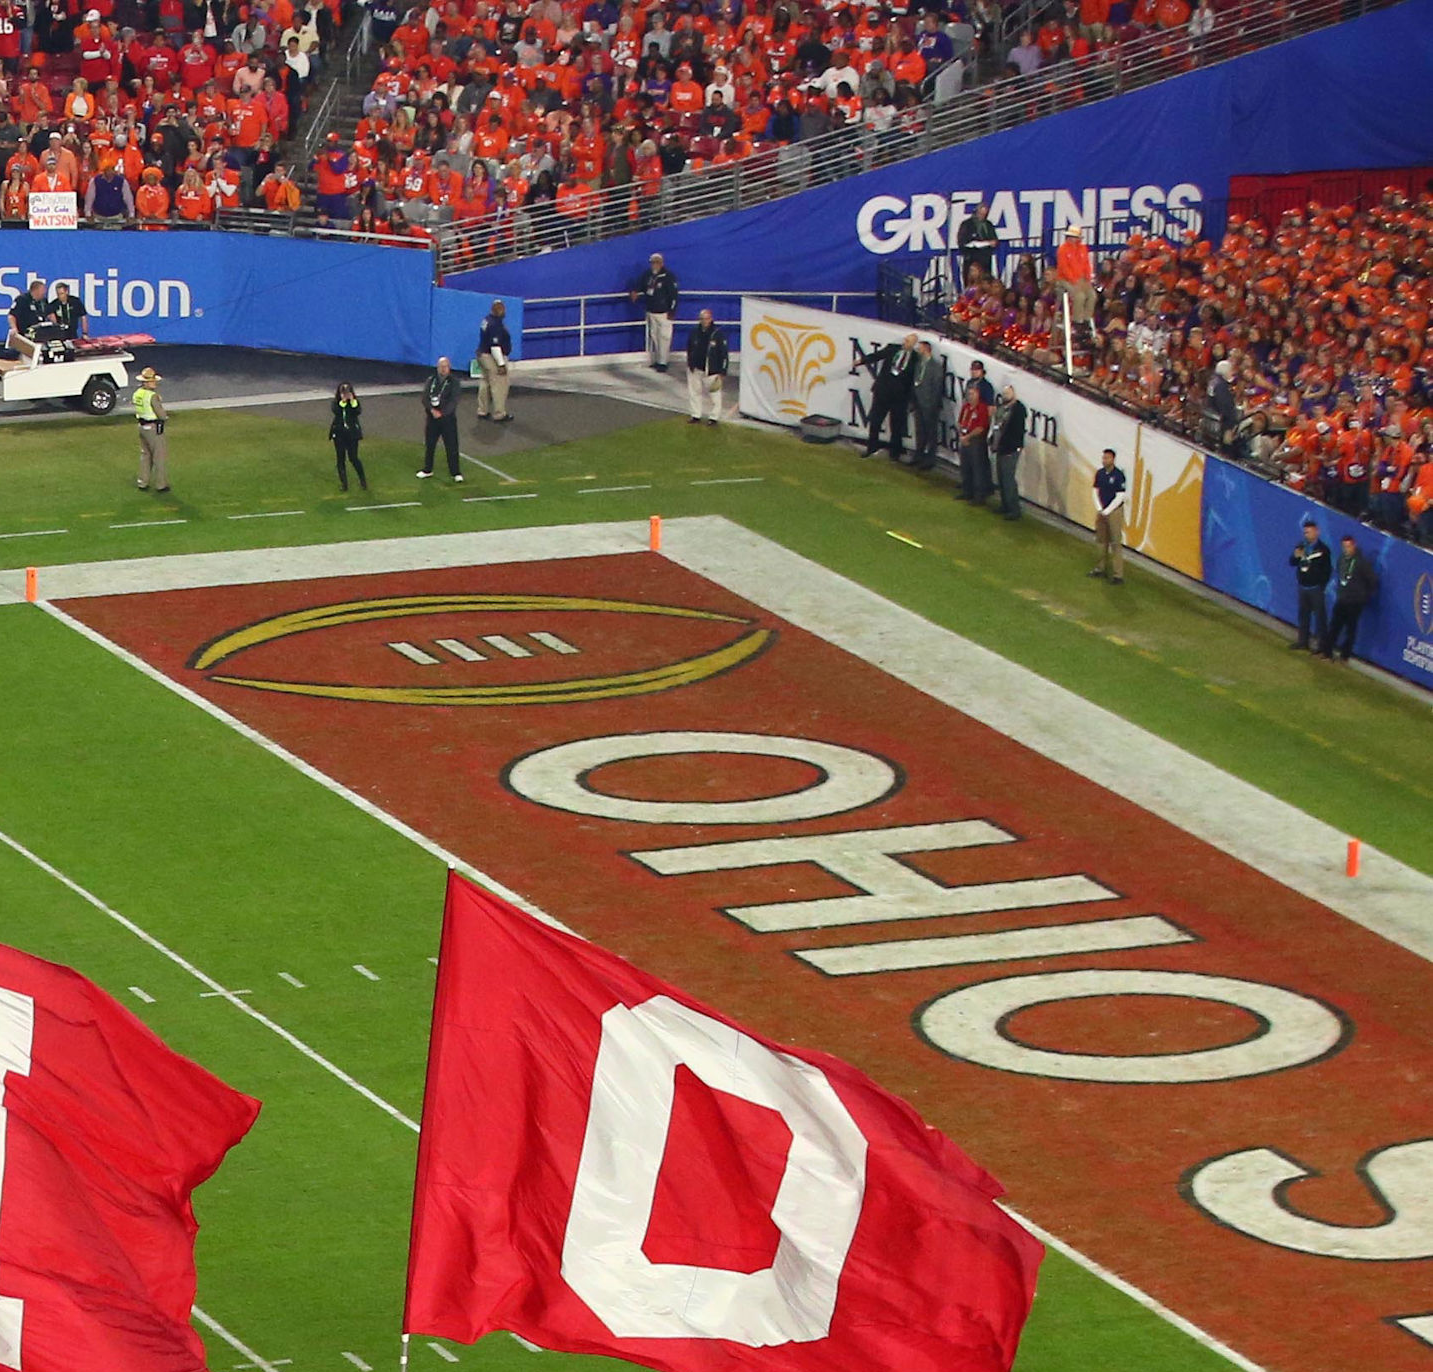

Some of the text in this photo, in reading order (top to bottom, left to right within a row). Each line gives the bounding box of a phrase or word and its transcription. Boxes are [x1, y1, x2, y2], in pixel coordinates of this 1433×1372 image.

[856, 183, 1203, 254] GREATNESS
[505, 730, 1350, 1083] OHIO
[560, 994, 868, 1348] O
